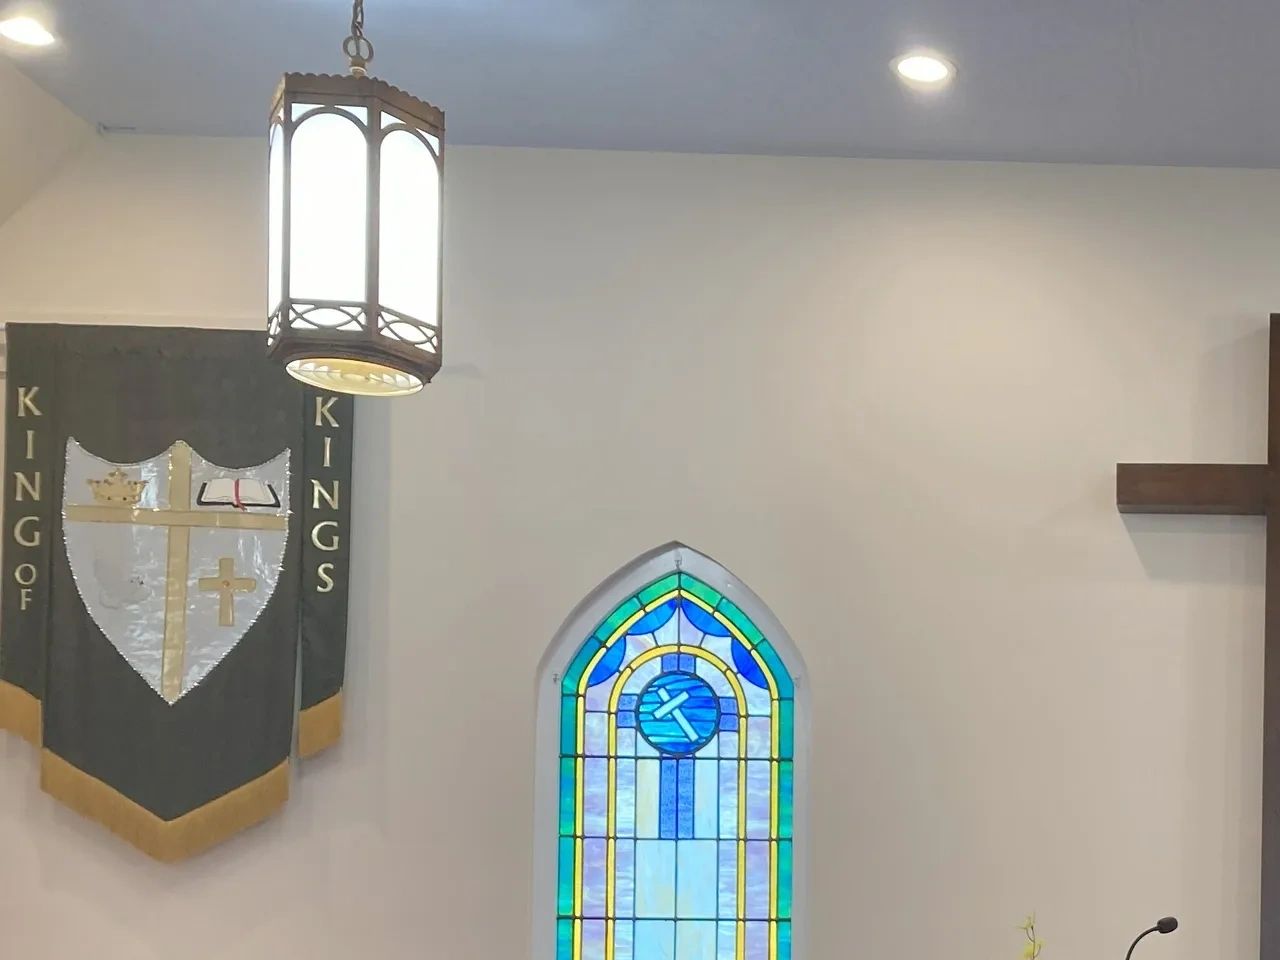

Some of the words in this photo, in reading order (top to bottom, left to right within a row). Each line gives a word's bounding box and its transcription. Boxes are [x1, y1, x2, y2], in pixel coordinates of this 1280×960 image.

[14, 386, 42, 547] KING
[311, 397, 339, 593] KINGS
[14, 563, 38, 611] OF
